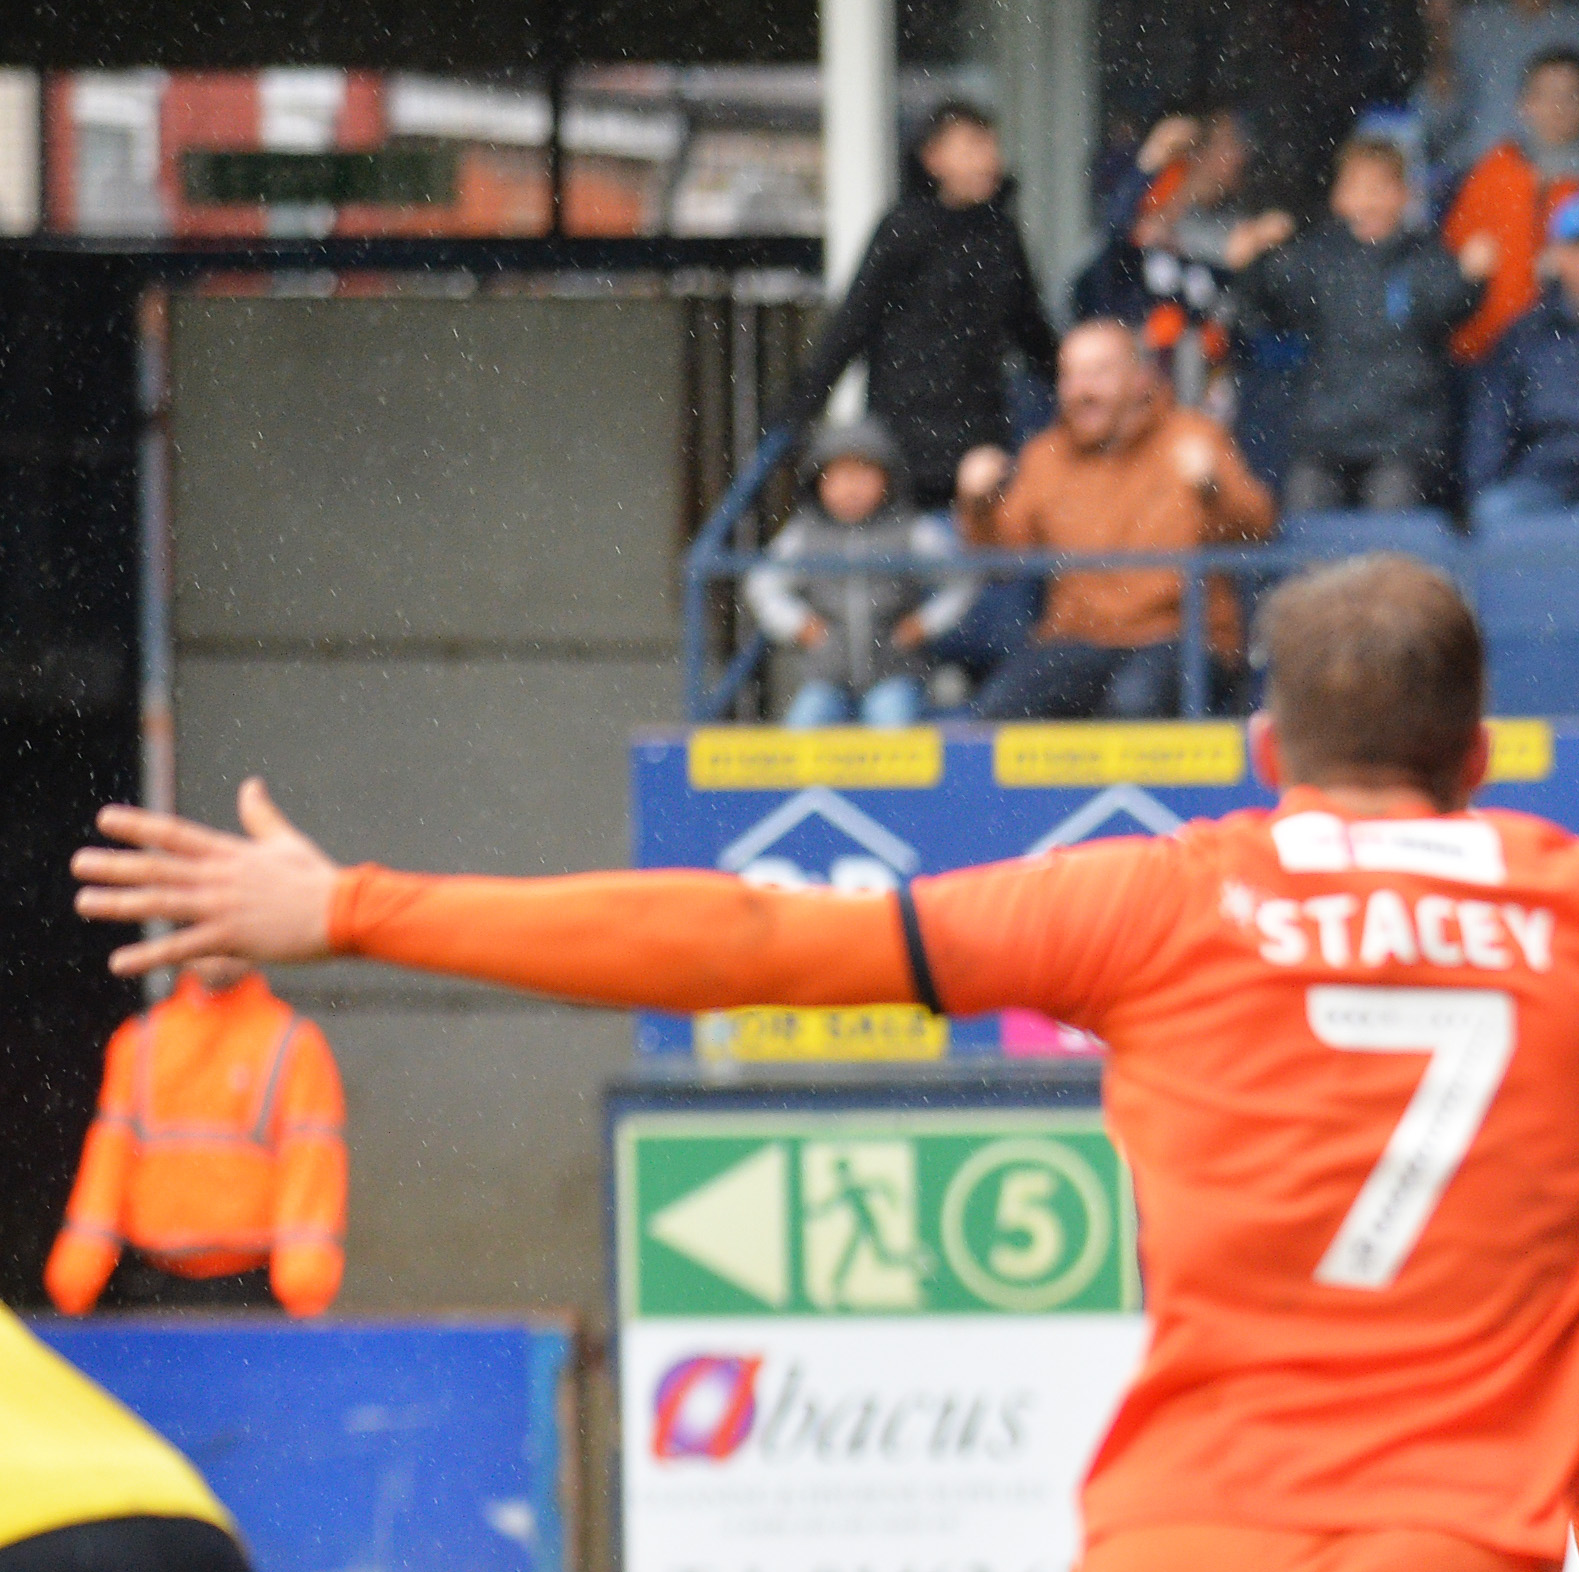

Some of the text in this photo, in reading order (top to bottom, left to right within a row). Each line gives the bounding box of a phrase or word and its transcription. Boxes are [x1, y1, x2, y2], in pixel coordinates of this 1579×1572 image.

[1255, 889, 1555, 971] STACEY
[1306, 984, 1517, 1291] 7
[987, 1168, 1064, 1283] 5
